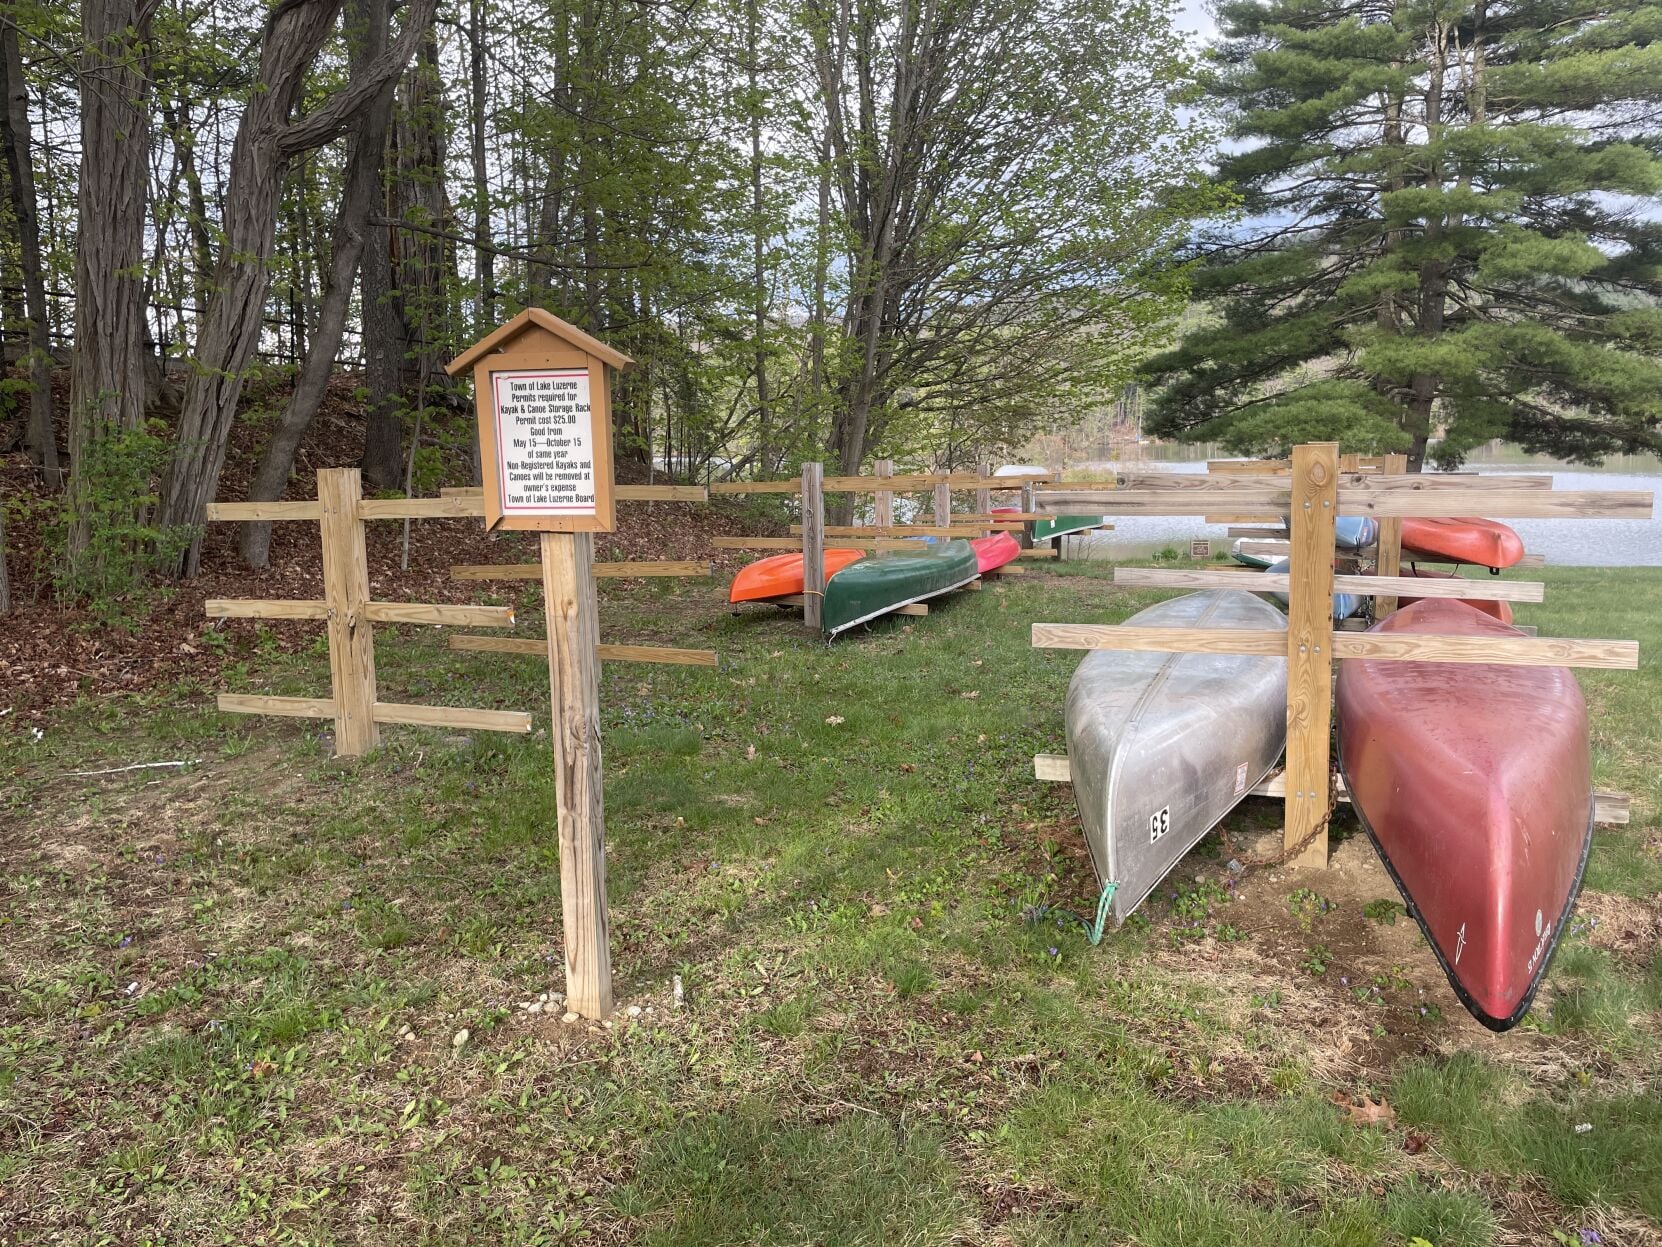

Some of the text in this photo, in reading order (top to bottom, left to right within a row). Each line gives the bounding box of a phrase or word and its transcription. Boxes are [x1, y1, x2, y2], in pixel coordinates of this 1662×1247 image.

[511, 381, 577, 391] Town of Lake Luzerne
[512, 394, 535, 402] Permits
[538, 393, 565, 402] required
[501, 403, 590, 414] Kayak & Canoe Storage Rack
[516, 415, 575, 424] Permit cost $25.00
[531, 427, 562, 436] Good from
[514, 439, 526, 448] May
[573, 438, 581, 446] 15
[556, 461, 577, 470] Kayaks
[580, 460, 591, 469] and
[510, 472, 530, 480] Canoes
[545, 472, 552, 480] be
[584, 472, 590, 480] at
[524, 483, 548, 492] owner's
[508, 495, 524, 503] Town
[526, 494, 531, 503] of
[550, 494, 573, 502] Luzerne
[576, 494, 594, 502] Board
[1152, 808, 1168, 841] 35
